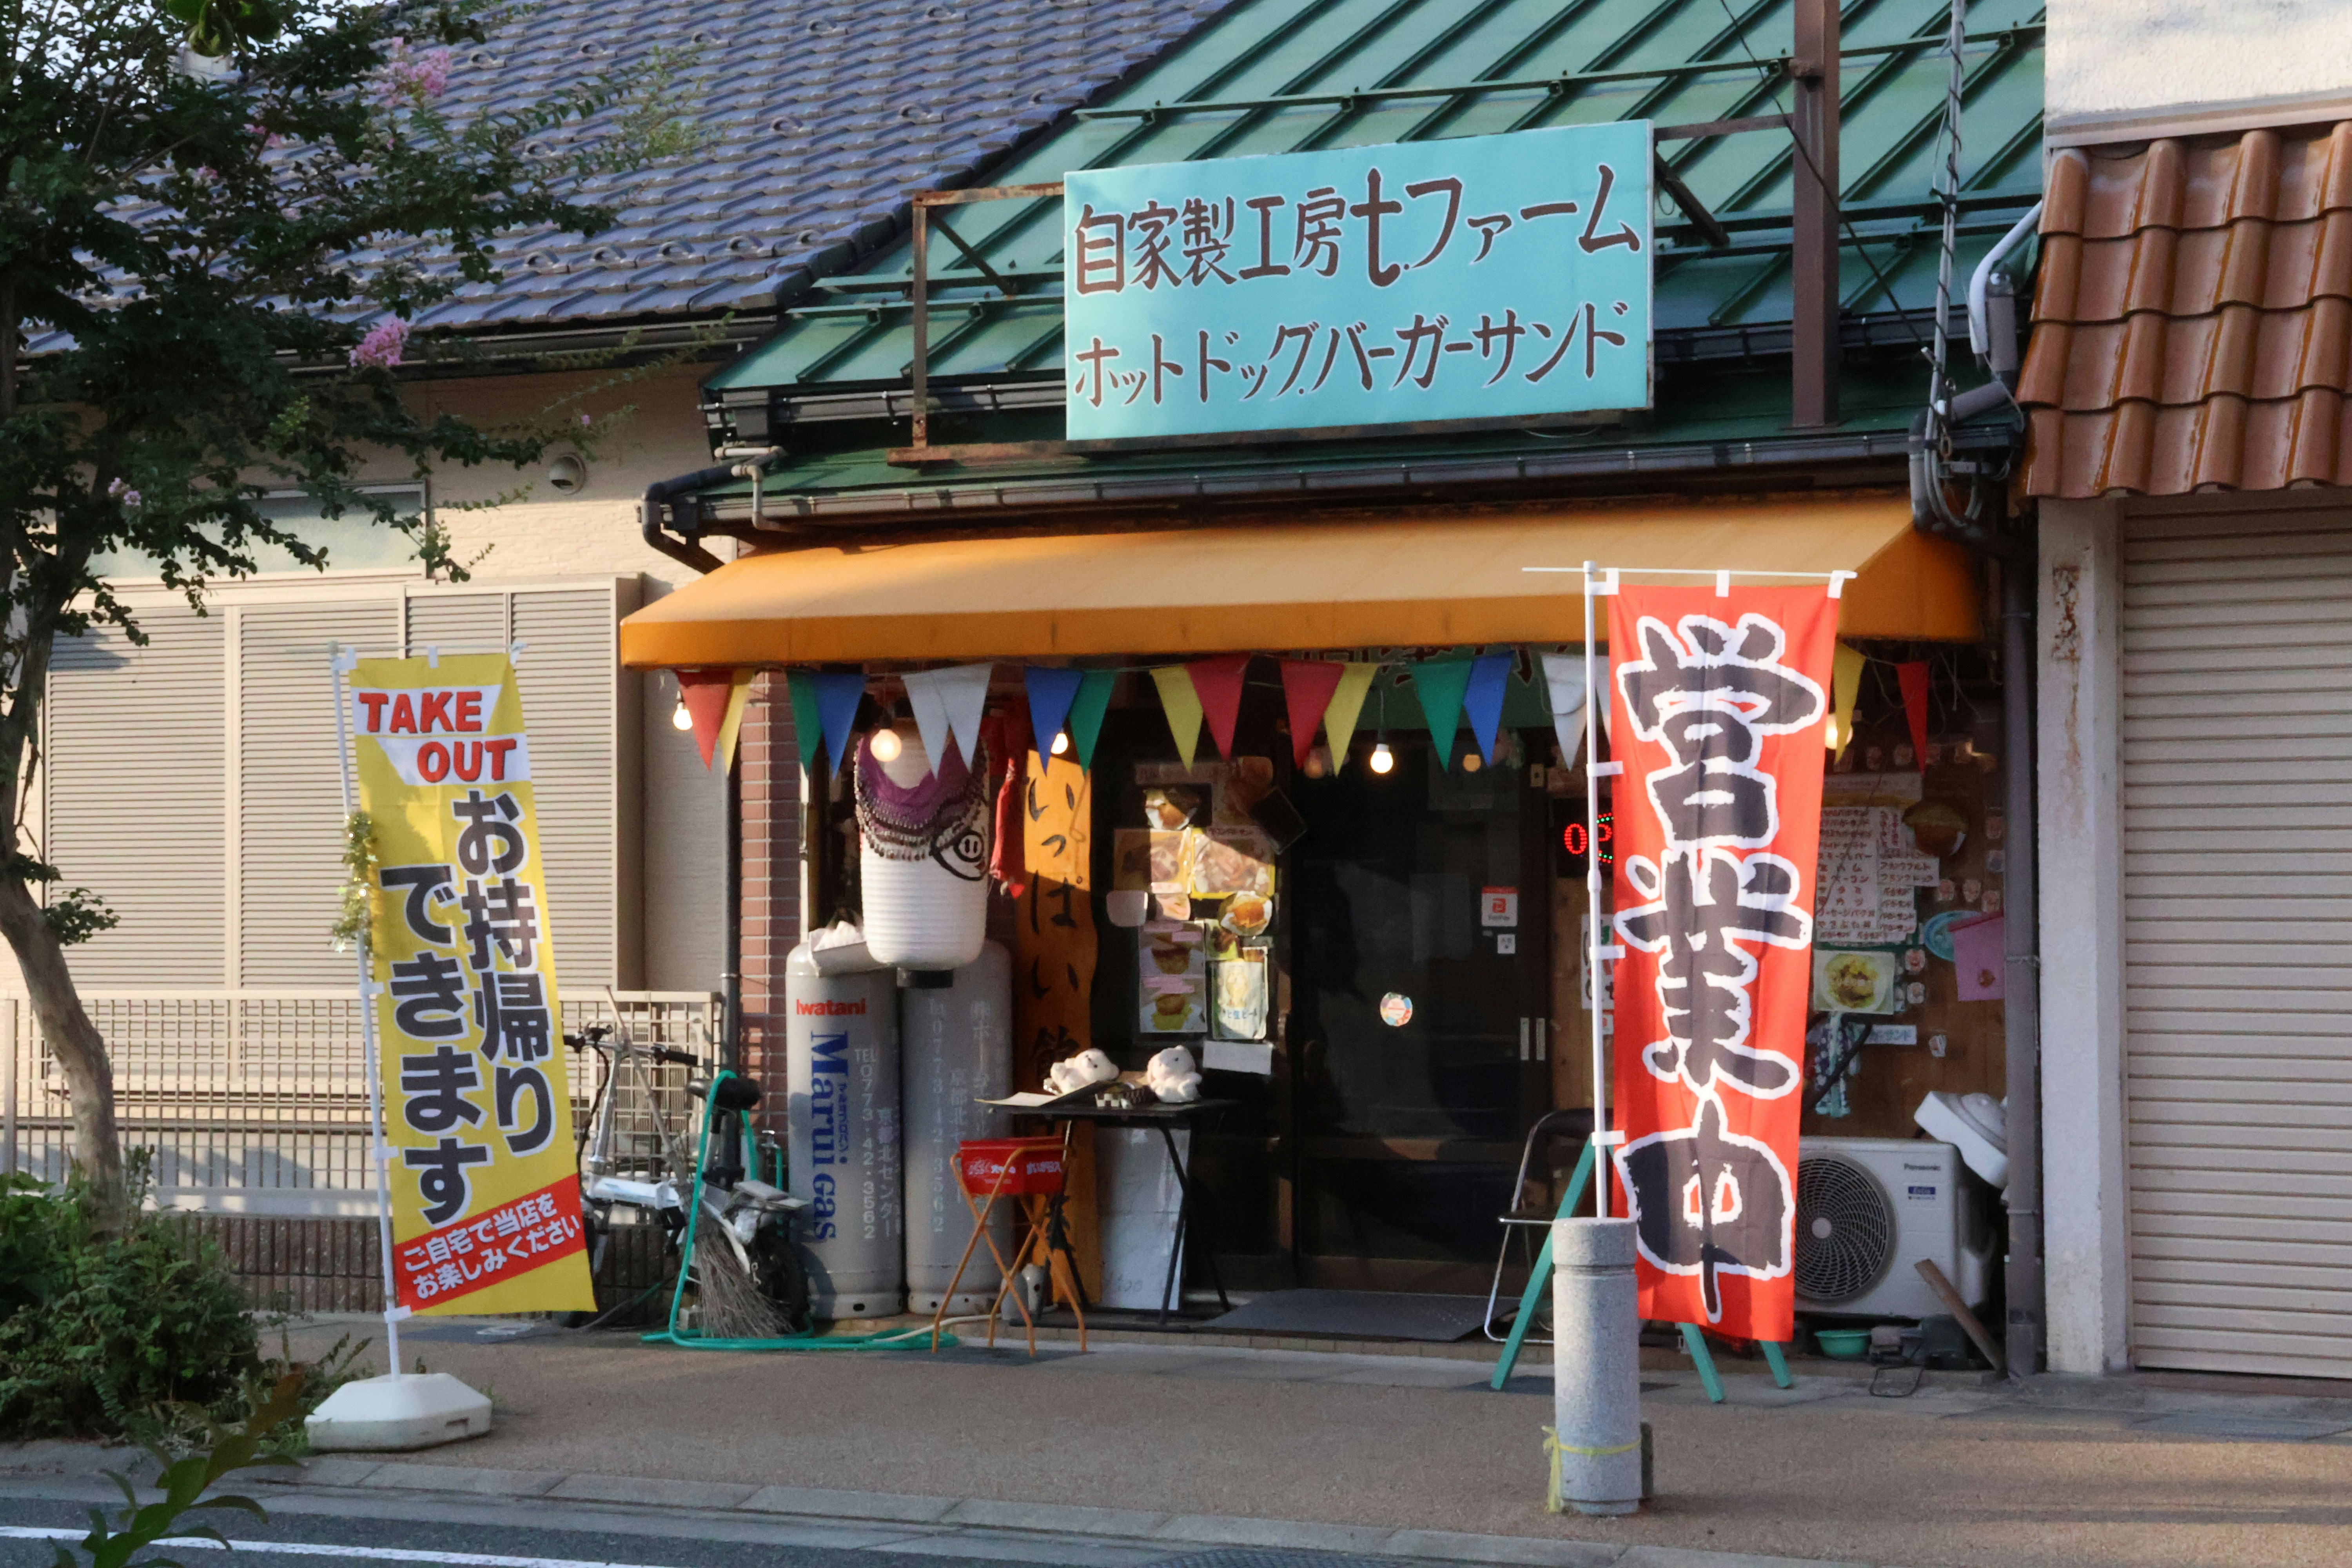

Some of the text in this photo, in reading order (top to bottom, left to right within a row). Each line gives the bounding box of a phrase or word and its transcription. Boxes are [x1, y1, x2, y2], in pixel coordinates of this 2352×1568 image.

[358, 691, 483, 733] TAKE
[417, 738, 517, 783] OUT
[453, 790, 552, 1153] お持帰り
[796, 998, 866, 1016] Iwatani
[1619, 618, 1821, 1317] 営業中
[379, 865, 487, 1225] できます
[811, 1030, 849, 1167] Marui
[403, 1193, 558, 1271] ご自宅で当店を
[413, 1214, 581, 1299] お楽しみください
